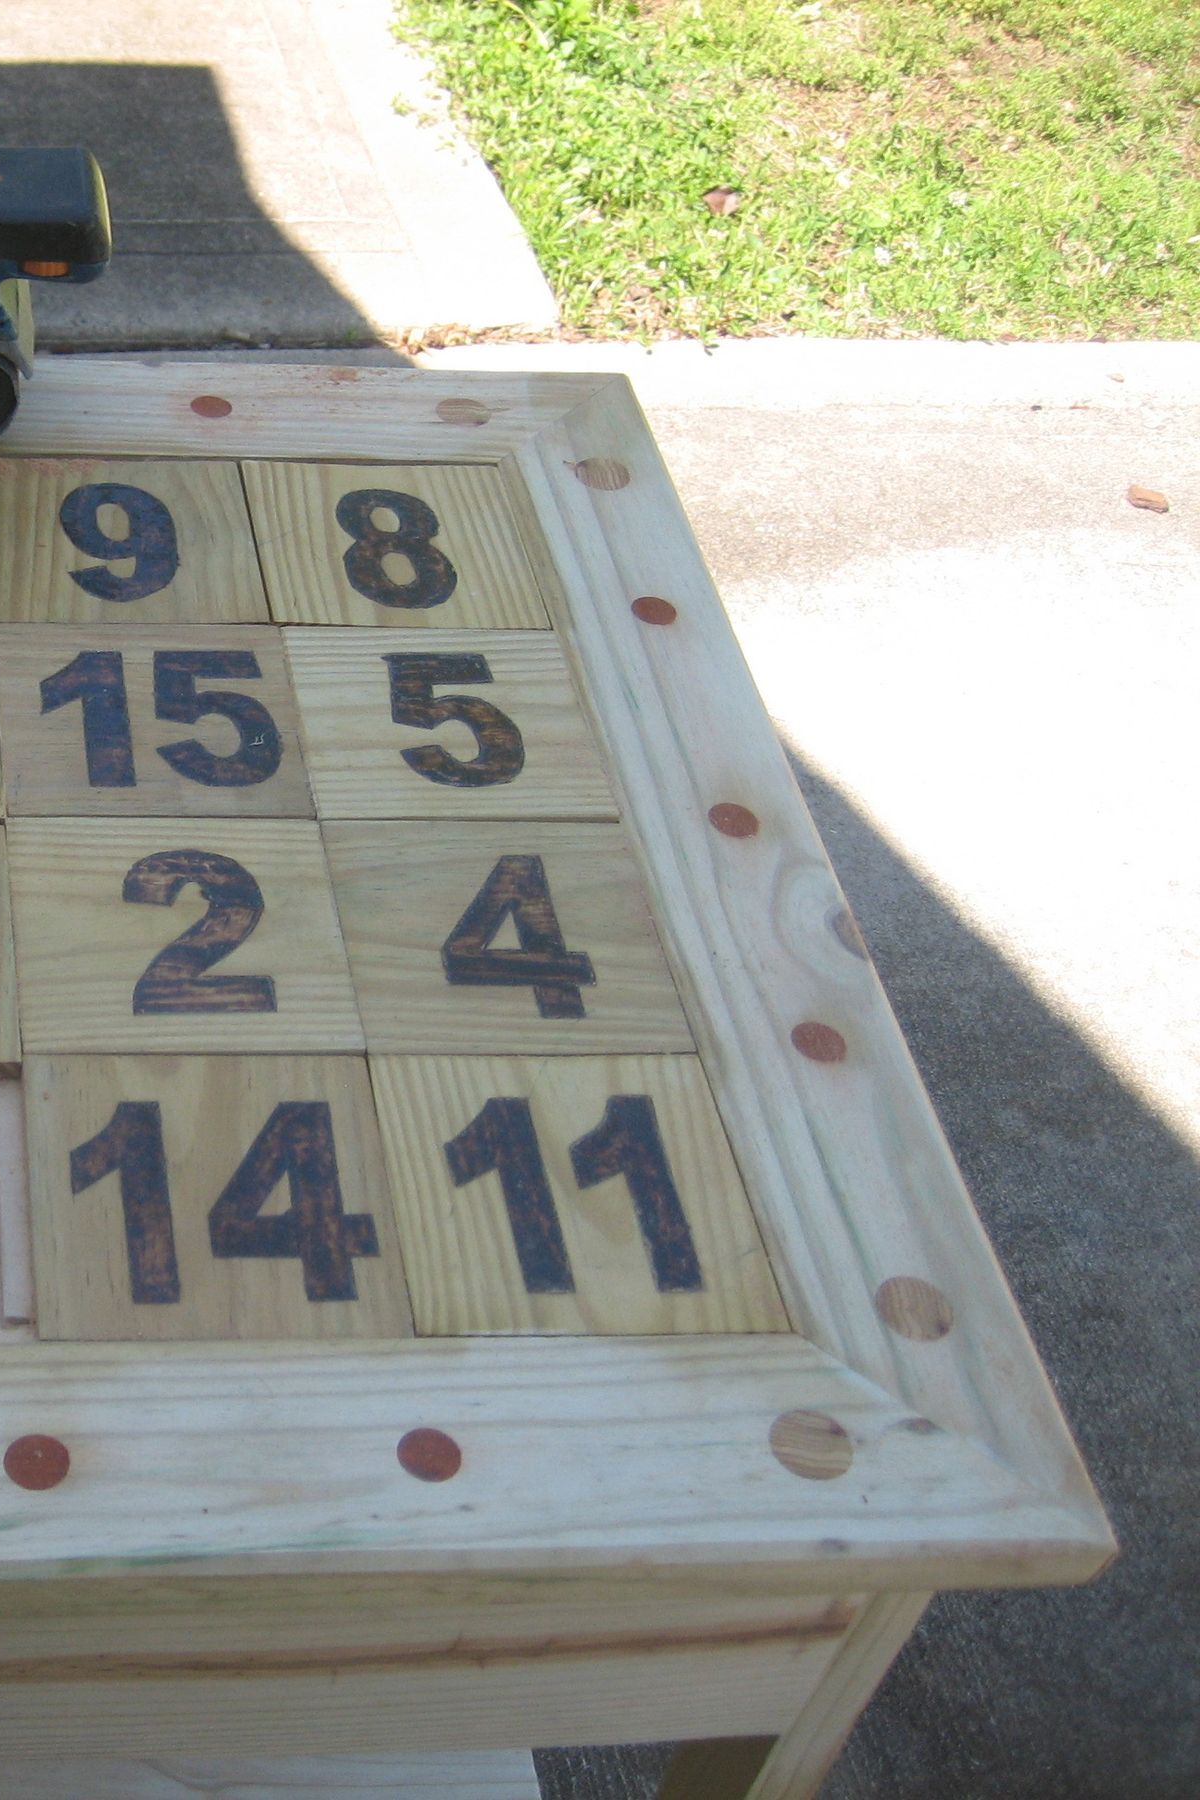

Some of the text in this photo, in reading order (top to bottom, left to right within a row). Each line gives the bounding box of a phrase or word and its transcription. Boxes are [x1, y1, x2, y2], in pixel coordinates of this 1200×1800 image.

[59, 482, 180, 601] 9
[335, 489, 457, 609] 8
[39, 650, 284, 788] 15
[380, 653, 526, 788] 5
[122, 849, 277, 1016] 2
[441, 854, 597, 1019] 4
[69, 1100, 380, 1304] 14
[443, 1095, 706, 1294] 11
